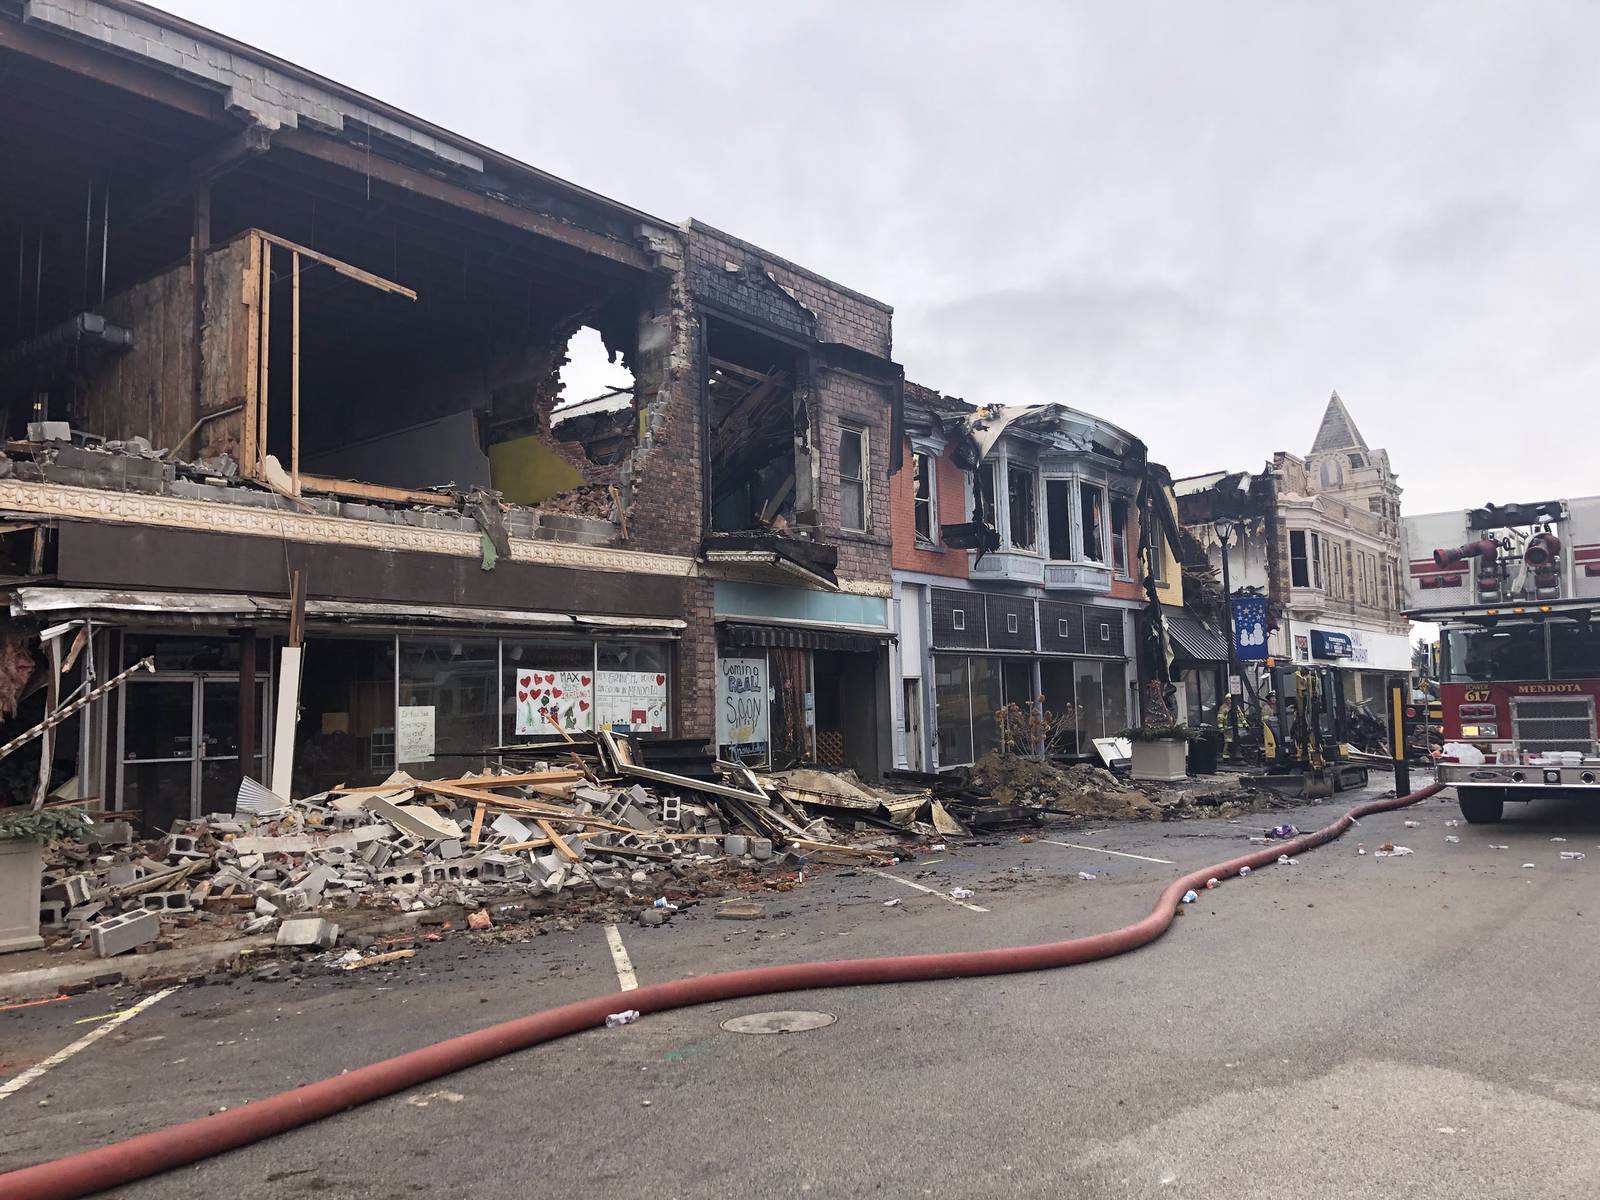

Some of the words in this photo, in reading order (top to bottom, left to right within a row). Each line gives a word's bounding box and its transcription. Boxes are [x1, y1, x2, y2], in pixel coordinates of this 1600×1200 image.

[560, 671, 580, 683] MAX
[1518, 683, 1582, 693] MENDOTA
[1465, 690, 1490, 701] 617
[727, 696, 761, 728] SOON
